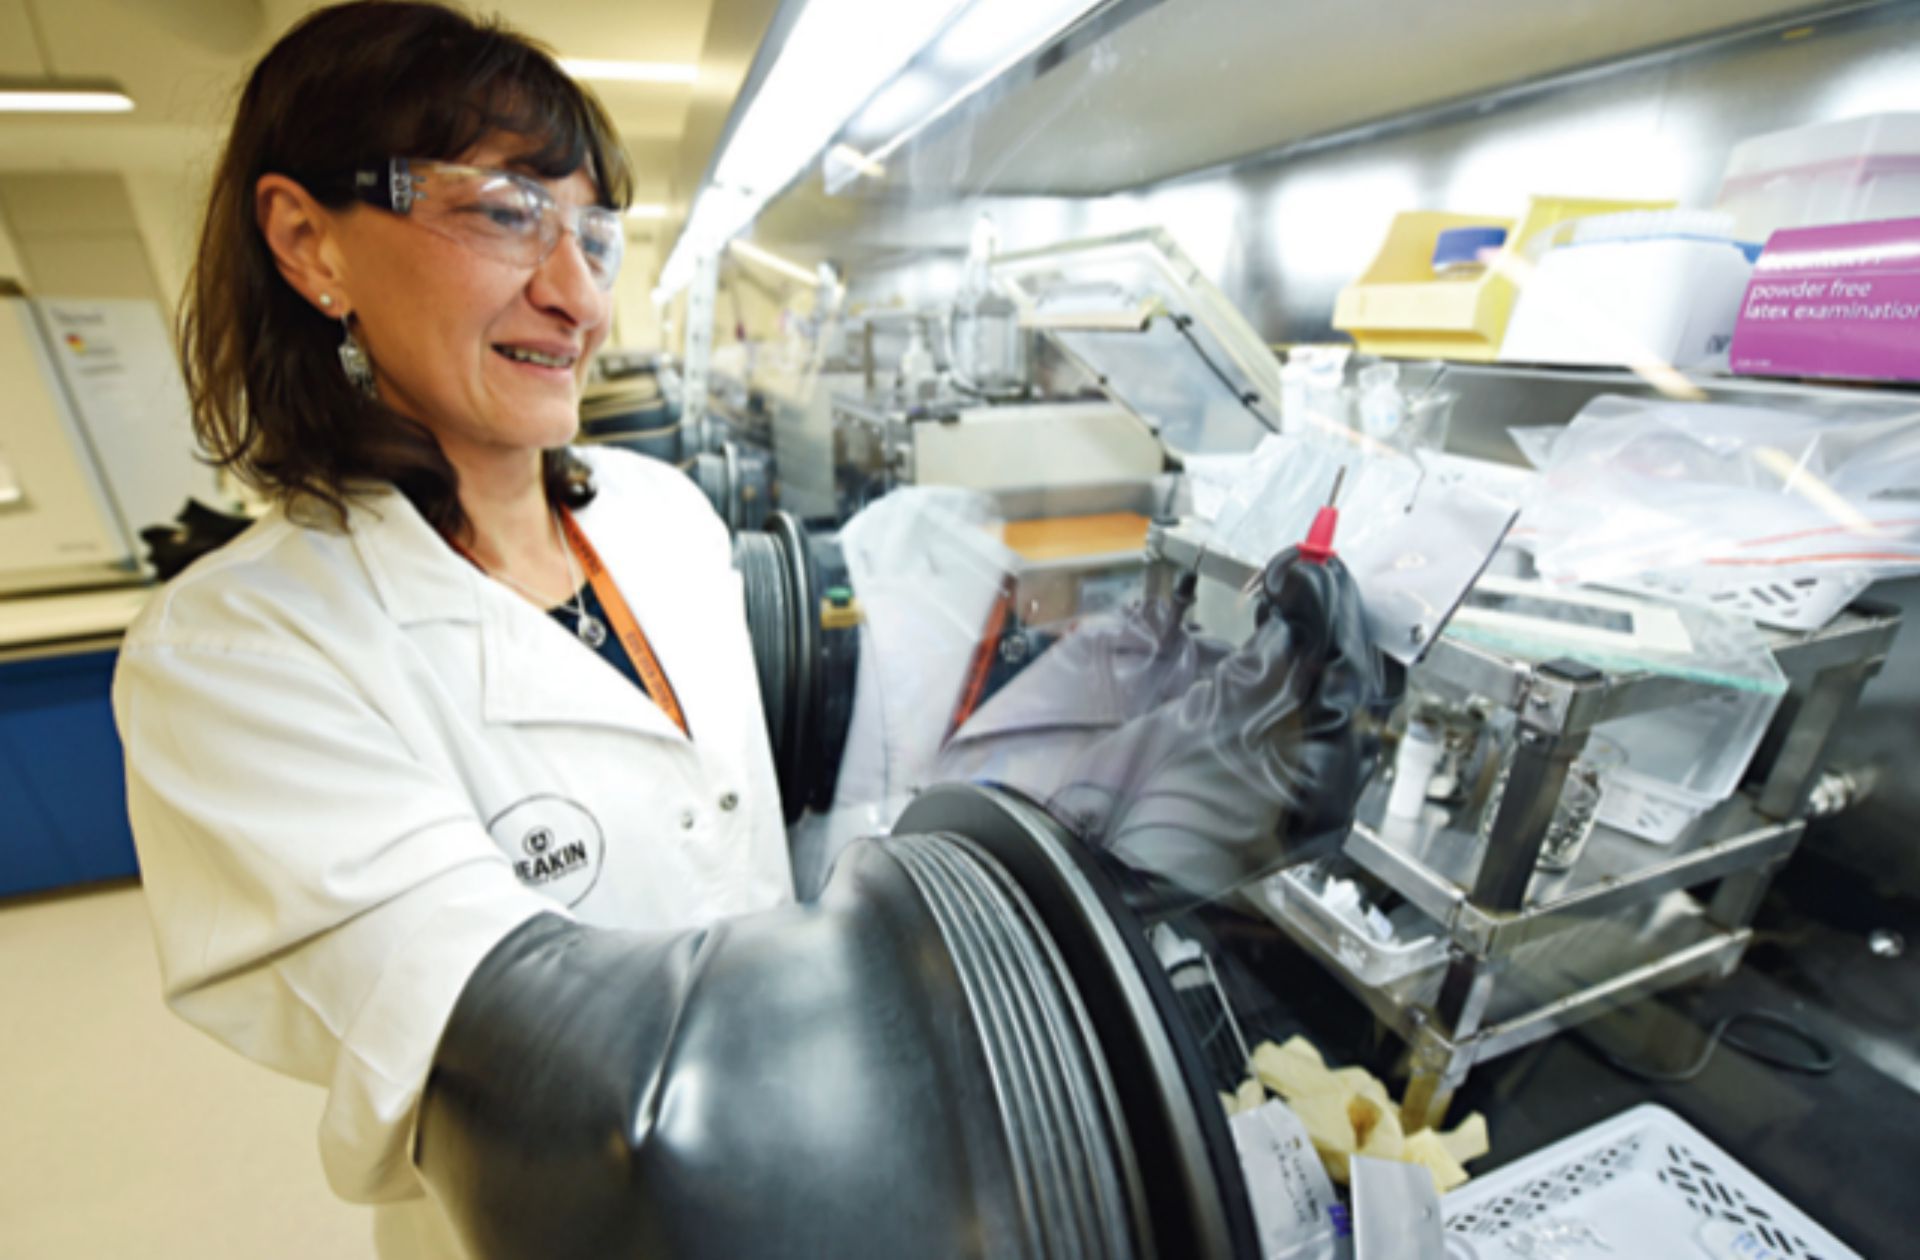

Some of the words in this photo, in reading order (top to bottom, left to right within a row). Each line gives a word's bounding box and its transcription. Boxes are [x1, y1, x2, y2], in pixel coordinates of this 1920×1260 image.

[1750, 280, 1826, 304] powder
[1831, 278, 1872, 298] free
[1745, 301, 1789, 320] latex
[514, 840, 586, 879] EAKIN
